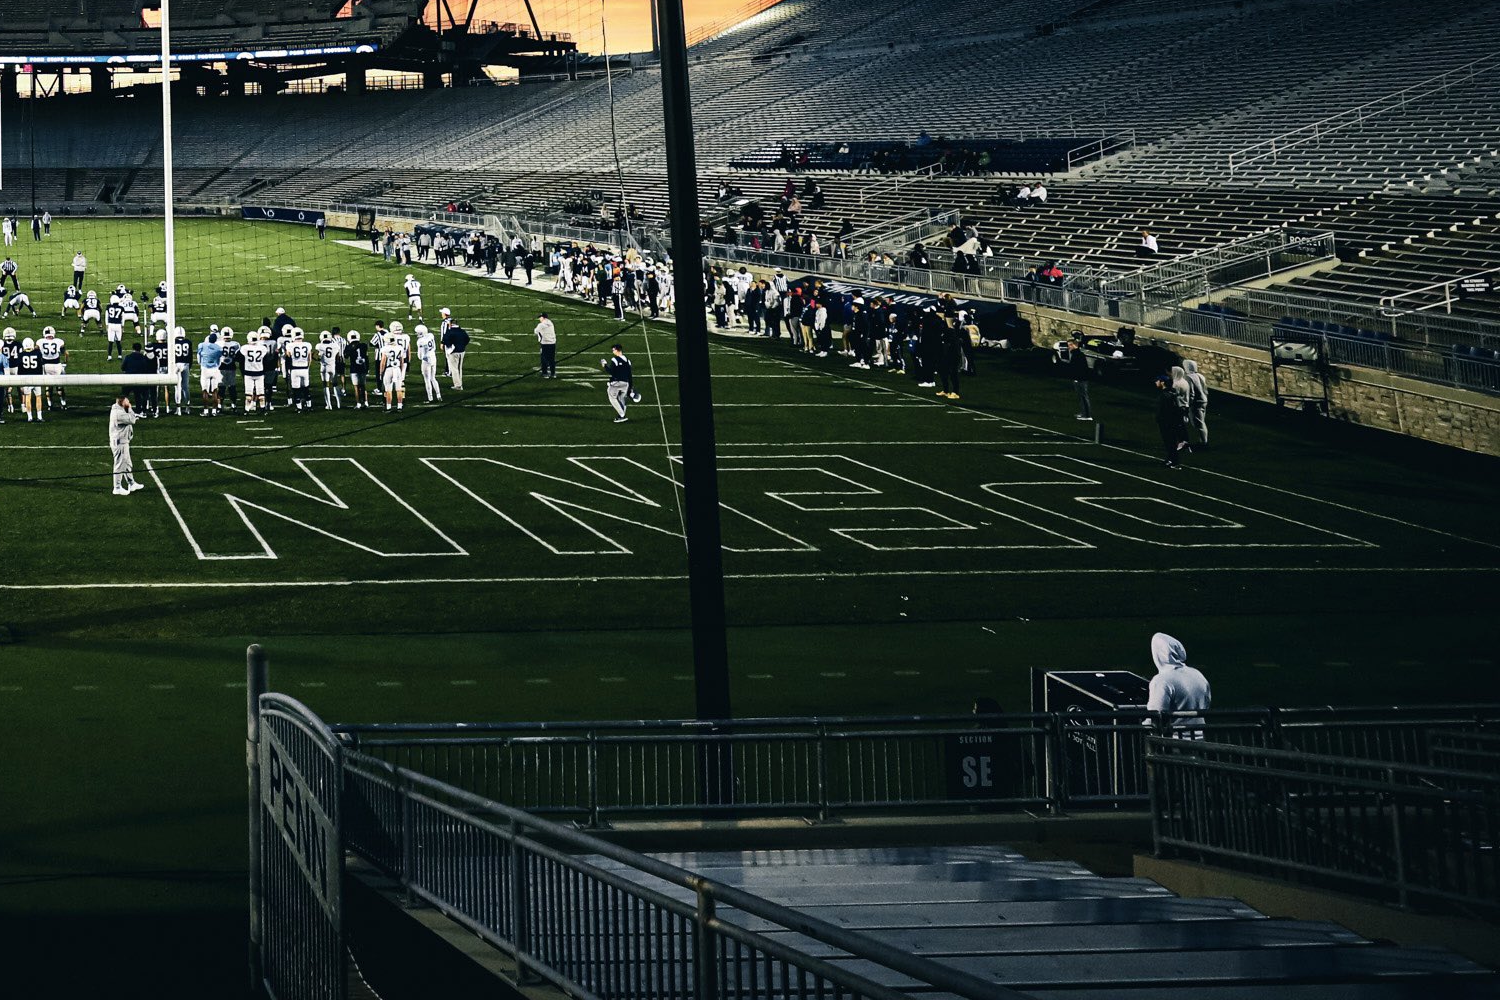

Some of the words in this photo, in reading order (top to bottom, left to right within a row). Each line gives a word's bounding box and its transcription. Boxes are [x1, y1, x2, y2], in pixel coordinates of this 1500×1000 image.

[108, 307, 122, 319] 97
[3, 345, 19, 359] 94
[42, 342, 57, 355] 53
[175, 342, 190, 357] 99
[222, 346, 235, 358] 66
[293, 346, 308, 358] 63
[325, 346, 333, 358] 6
[22, 355, 38, 369] 95
[247, 350, 262, 363] 52
[959, 735, 994, 745] SECTION
[962, 755, 992, 788] SE
[269, 742, 327, 902] PENN
